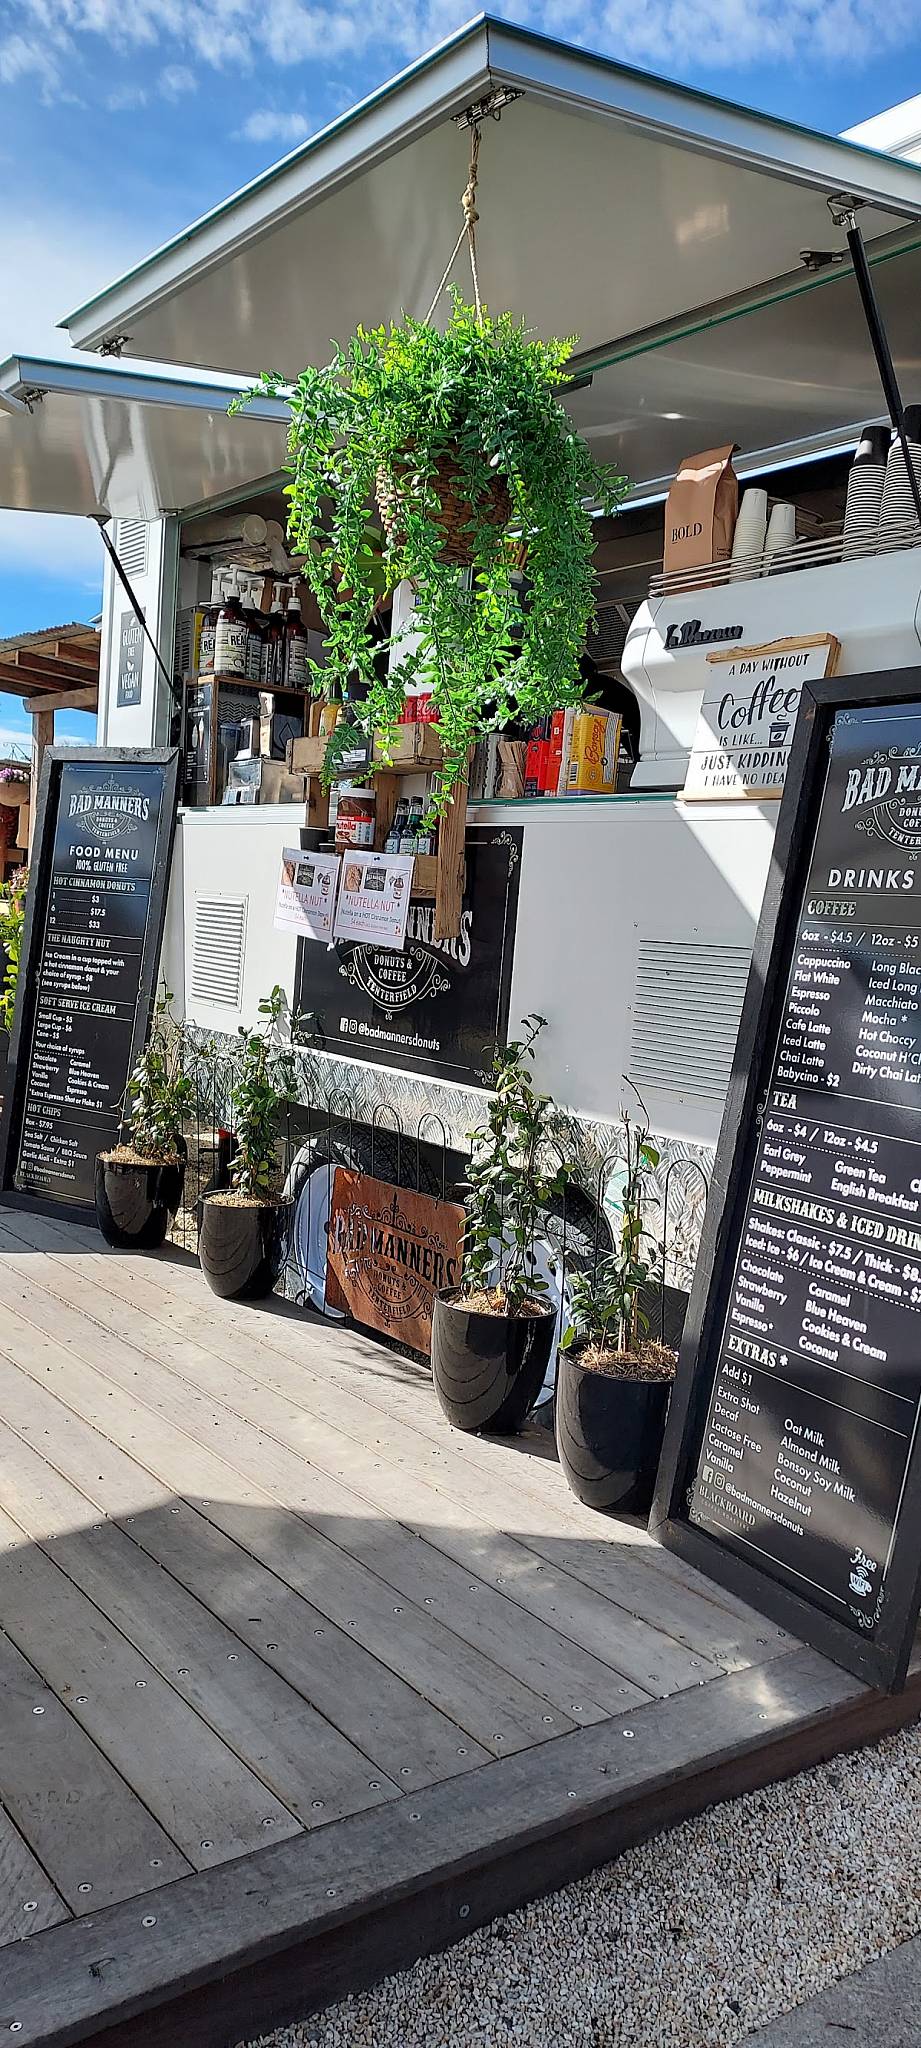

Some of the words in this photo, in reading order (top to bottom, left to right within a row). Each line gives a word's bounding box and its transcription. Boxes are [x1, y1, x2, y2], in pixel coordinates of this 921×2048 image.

[672, 522, 702, 545] BOLD
[728, 665, 735, 676] A
[740, 661, 758, 675] DAY
[761, 653, 810, 672] WITHOUT
[717, 675, 801, 731] Coffee
[719, 735, 728, 747] IS
[701, 755, 734, 771] JUST
[713, 774, 737, 787] HAVE
[742, 773, 757, 785] NO
[761, 771, 785, 785] IDEA
[841, 766, 891, 813] BAD
[68, 794, 91, 818] BAD
[93, 794, 150, 821] MANNERS
[69, 845, 101, 858] FOOD
[104, 847, 139, 861] MENU
[75, 859, 92, 871] 100%
[93, 860, 115, 873] GLUTEN
[115, 862, 129, 874] FREE
[53, 876, 69, 887] HOT
[69, 877, 107, 890] CINNAMON
[107, 880, 136, 892] DONUTS
[827, 869, 915, 890] DRINKS
[50, 904, 56, 912] 6
[91, 895, 100, 905] $3
[807, 899, 857, 917] COFFEE
[49, 917, 56, 925] 12
[88, 920, 101, 930] $33
[47, 933, 61, 943] THE
[61, 935, 95, 948] NAUGHTY
[95, 938, 111, 949] NUT
[801, 929, 820, 942] 6oz
[830, 930, 853, 943] $4.5
[871, 933, 895, 947] 12oz
[374, 953, 405, 969] DONUTS
[406, 958, 413, 970] &
[797, 953, 851, 970] Cappuccino
[871, 960, 897, 976] Long
[378, 967, 407, 983] COFFEE
[793, 969, 813, 982] Flat
[814, 971, 841, 985] White
[868, 976, 889, 991] Iced
[891, 979, 918, 996] Long
[366, 976, 418, 1002] TENTERFIELD
[791, 985, 831, 1001] Espresso
[39, 995, 58, 1007] SOFT
[58, 997, 80, 1010] SERVE
[79, 1000, 91, 1012] ICE
[91, 1002, 117, 1015] CREAM
[788, 1001, 821, 1017] Piccolo
[864, 993, 919, 1011] Macchiato
[785, 1018, 806, 1031] Cafe
[807, 1020, 832, 1036] Latte
[861, 1010, 897, 1027] Mocha
[358, 1021, 441, 1052] @badmannersdonuts
[782, 1033, 801, 1046] Iced
[803, 1036, 827, 1052] Latte
[858, 1027, 877, 1041] Hot
[879, 1029, 917, 1049] Choccy
[33, 1053, 57, 1063] Chocolate
[780, 1049, 801, 1063] Chai
[801, 1052, 825, 1068] Latte
[855, 1044, 898, 1062] Coconut
[31, 1070, 49, 1080] Vanilla
[32, 1061, 60, 1074] Strawberry
[777, 1065, 819, 1084] Babycino
[826, 1071, 841, 1087] $2
[851, 1060, 878, 1080] Dirty
[879, 1066, 904, 1082] Chai
[30, 1079, 51, 1089] Coconut
[772, 1090, 797, 1110] TEA
[42, 1105, 62, 1118] CHIPS
[766, 1118, 784, 1134] 6oz
[794, 1122, 808, 1138] $4
[823, 1130, 847, 1148] 12oz
[854, 1136, 879, 1154] $4.5
[763, 1142, 782, 1158] Earl
[782, 1147, 807, 1167] Grey
[760, 1159, 813, 1184] Peppermint
[834, 1159, 866, 1179] Green
[868, 1170, 887, 1184] Tea
[830, 1177, 866, 1200] English
[867, 1186, 919, 1212] Breakfast
[753, 1187, 836, 1225] MILKSHAKES
[836, 1211, 849, 1230] &
[850, 1214, 885, 1240] ICED
[748, 1217, 786, 1240] Shakes:
[786, 1228, 822, 1251] Classic
[828, 1240, 852, 1260] $7.5
[864, 1252, 894, 1275] Thick
[369, 1225, 458, 1290] MANNERS
[745, 1233, 767, 1250] Iced:
[767, 1240, 781, 1256] Ice
[786, 1245, 800, 1262] $6
[808, 1254, 823, 1270] Ice
[824, 1259, 857, 1282] Cream
[857, 1270, 867, 1285] &
[868, 1273, 903, 1297] Cream
[741, 1258, 785, 1284] Chocolate
[737, 1274, 788, 1306] Strawberry
[808, 1282, 852, 1308] Caramel
[734, 1291, 766, 1314] Vanilla
[805, 1299, 827, 1319] Blue
[827, 1308, 868, 1334] Heaven
[727, 1333, 778, 1368] EXTRAS
[798, 1335, 840, 1362] Coconut
[801, 1317, 841, 1343] Cookies
[841, 1332, 851, 1348] &
[852, 1337, 888, 1362] Cream
[721, 1362, 742, 1381] Add
[742, 1371, 753, 1386] $1
[714, 1400, 740, 1422] Decaf
[717, 1385, 741, 1404] Extra
[740, 1396, 761, 1416] Shot
[711, 1416, 742, 1442] Lactose
[742, 1434, 763, 1453] Free
[784, 1417, 803, 1435] Oat
[803, 1427, 826, 1448] Milk
[708, 1432, 745, 1460] Caramel
[780, 1435, 819, 1462] Almond
[819, 1453, 841, 1476] Milk
[705, 1447, 735, 1474] Vanilla
[773, 1467, 813, 1497] Coconut
[777, 1451, 812, 1481] Bonsoy
[812, 1470, 833, 1493] Soy
[833, 1480, 857, 1503] Milk
[699, 1484, 756, 1527] BLACKBOARD
[724, 1481, 805, 1537] @badmannersdonuts
[770, 1484, 813, 1518] Hazelnut
[849, 1546, 878, 1573] Free
